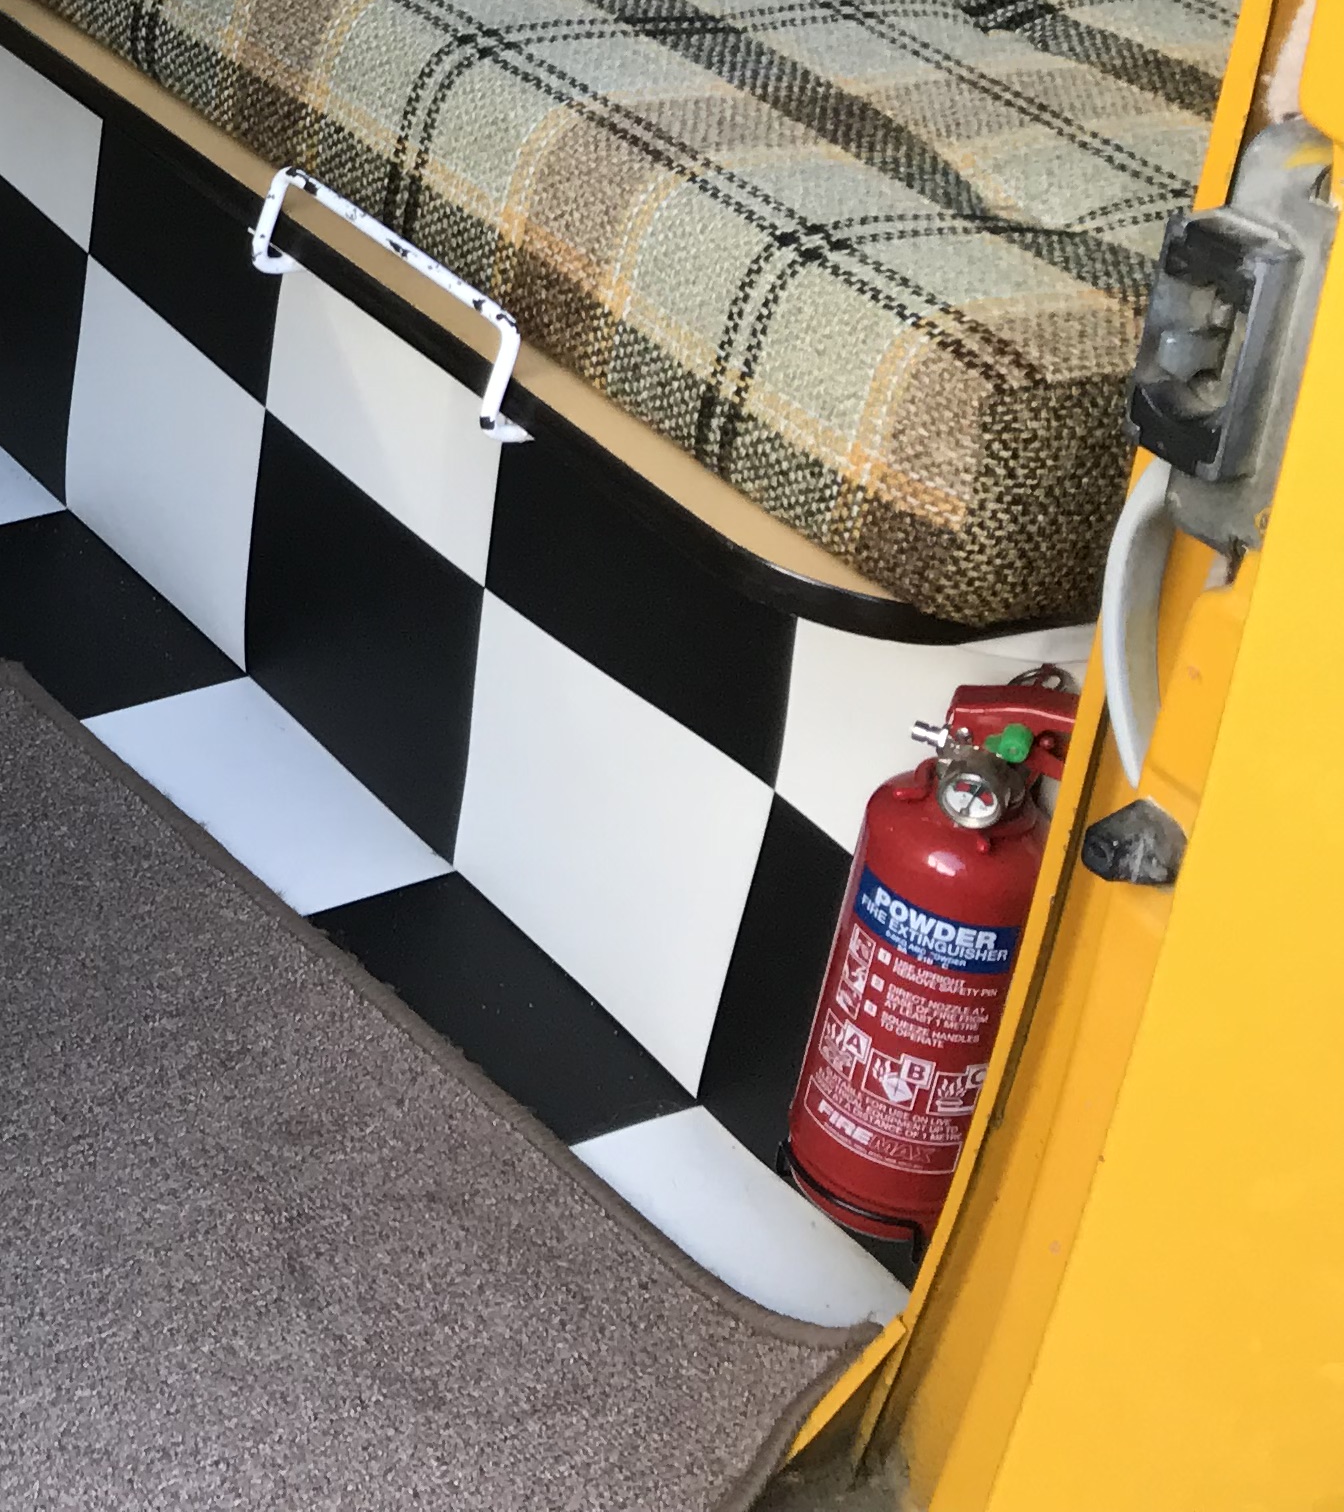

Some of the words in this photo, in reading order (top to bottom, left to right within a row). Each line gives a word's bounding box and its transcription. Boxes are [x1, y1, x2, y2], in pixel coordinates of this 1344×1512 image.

[862, 893, 887, 925] FIRE
[889, 917, 1008, 962] EXTINGUISHER
[876, 886, 998, 950] POWDER
[845, 1032, 863, 1055] A
[907, 1064, 925, 1081] B
